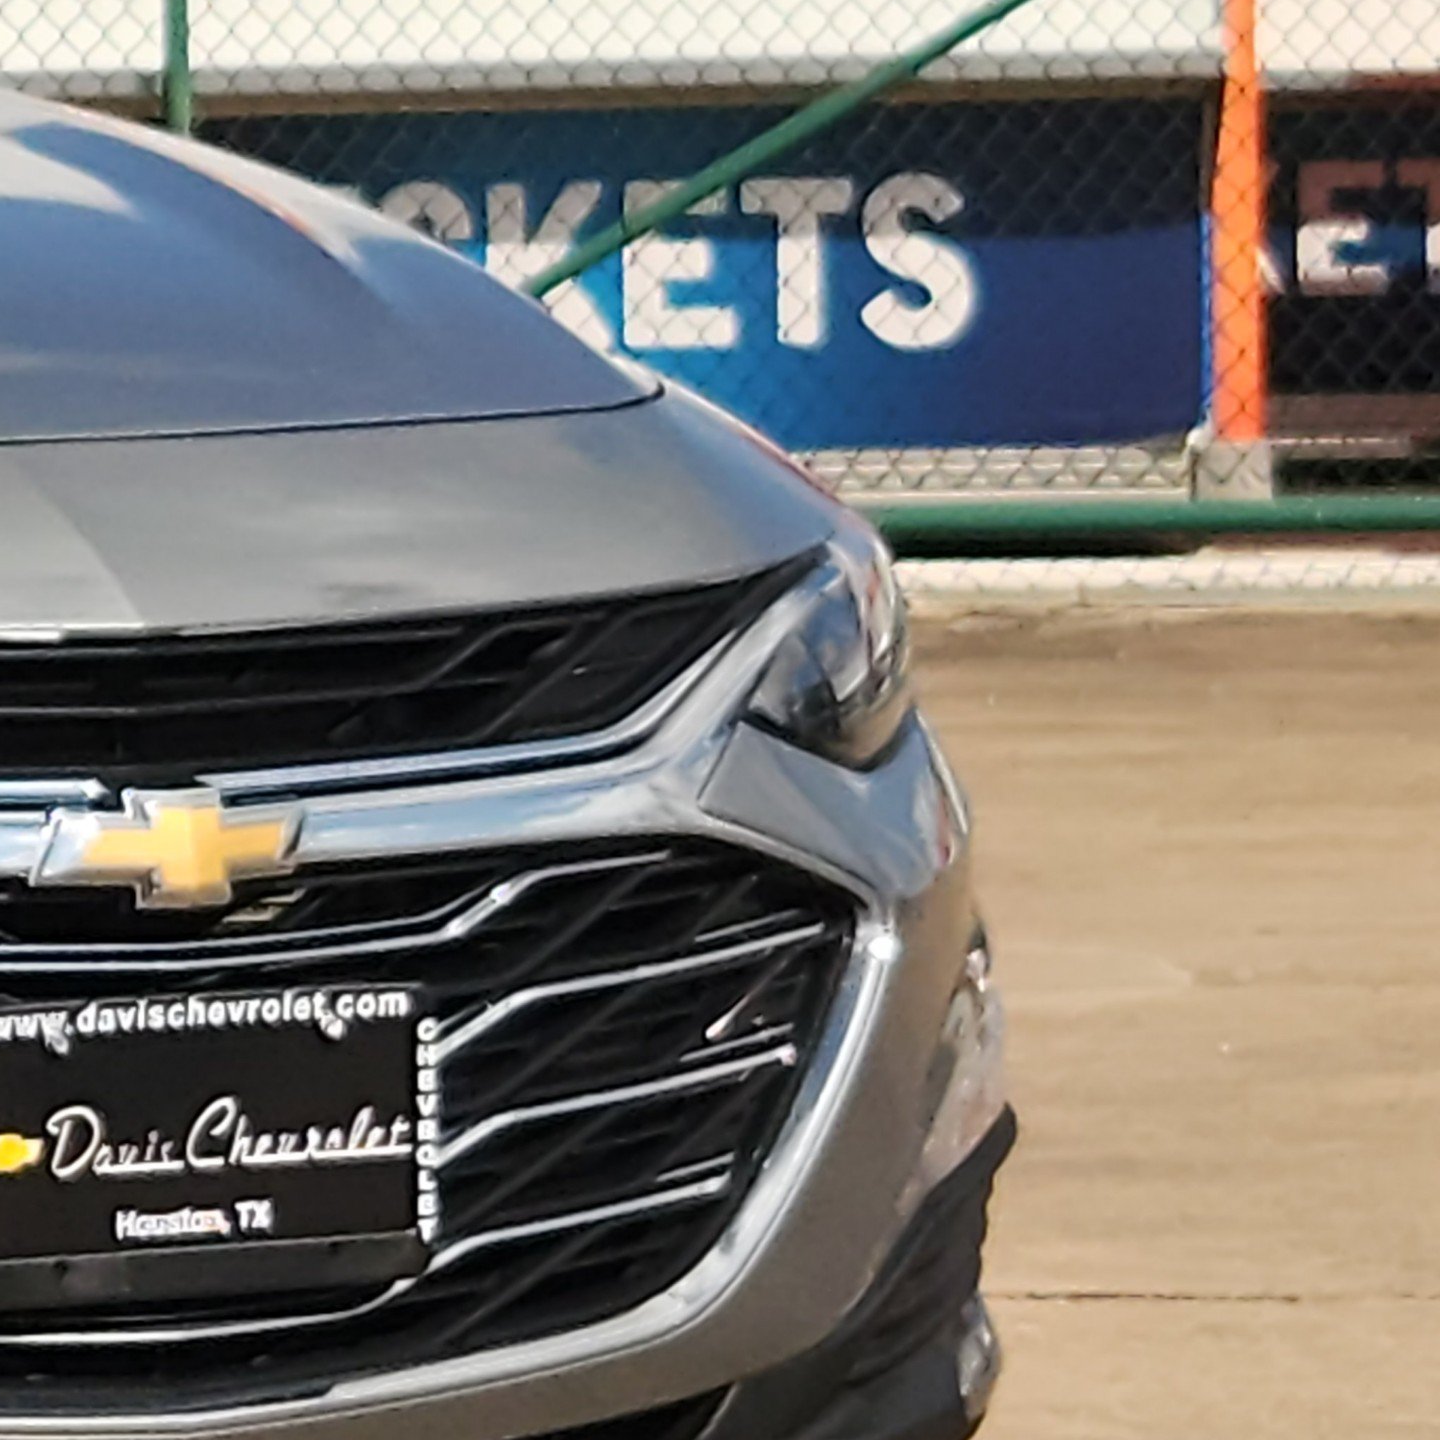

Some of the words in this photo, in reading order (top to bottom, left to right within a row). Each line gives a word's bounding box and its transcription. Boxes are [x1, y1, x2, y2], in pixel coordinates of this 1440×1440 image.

[46, 1104, 184, 1179] Davis
[186, 1095, 412, 1167] Chevrolet
[236, 1197, 273, 1233] TX
